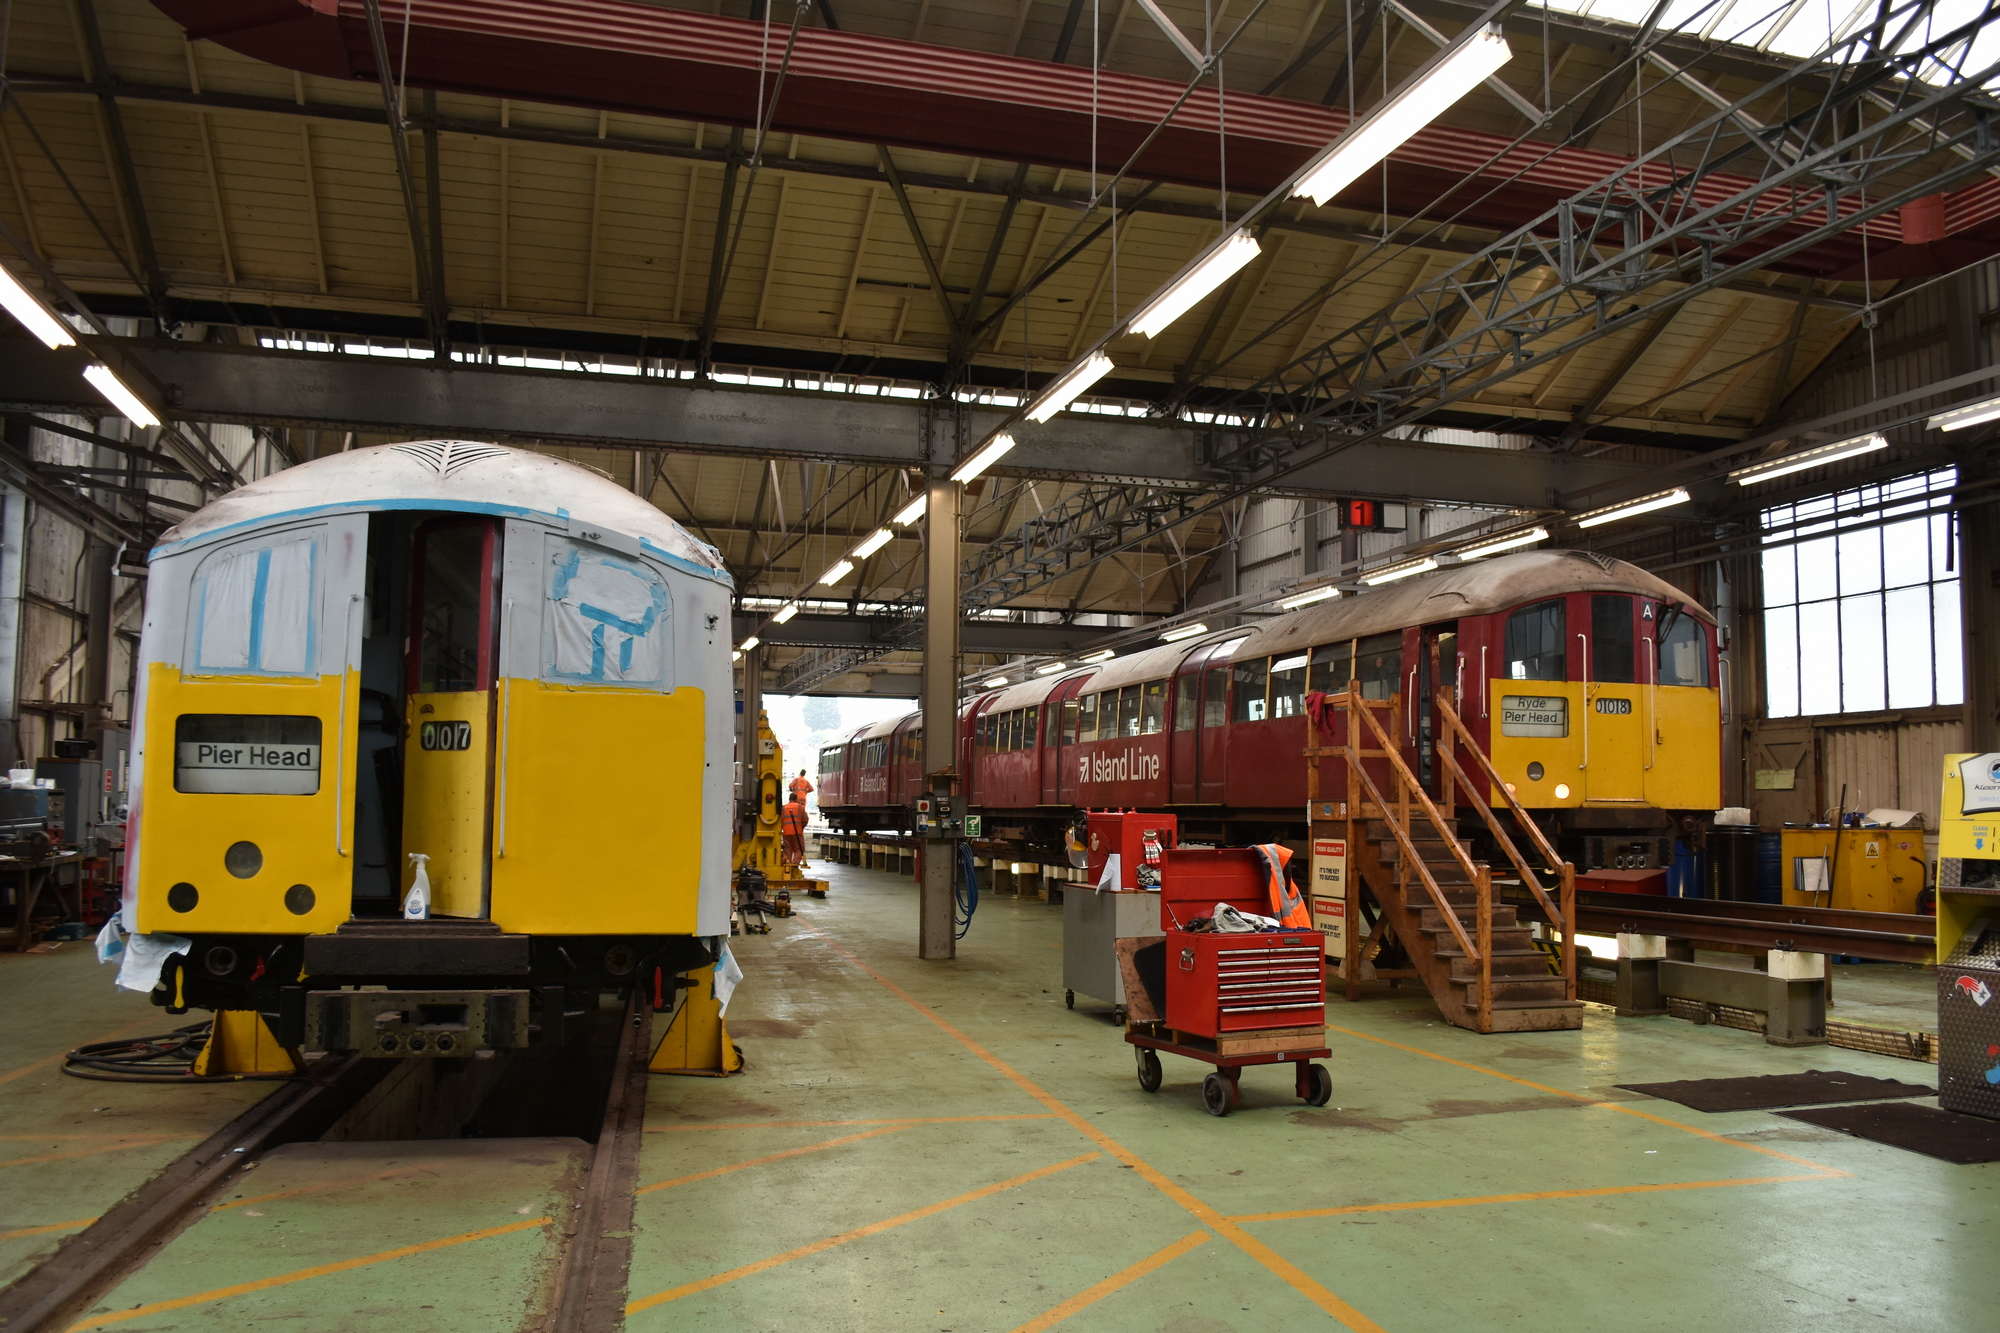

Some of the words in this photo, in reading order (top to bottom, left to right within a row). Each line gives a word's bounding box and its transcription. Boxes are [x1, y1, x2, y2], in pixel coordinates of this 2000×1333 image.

[1355, 503, 1365, 526] 1
[1642, 604, 1653, 618] A
[1518, 697, 1546, 710] Ryde
[1505, 711, 1526, 722] Pier
[1528, 712, 1557, 723] Head
[198, 744, 243, 764] Pier
[250, 746, 311, 766] Head
[1092, 748, 1127, 782] Island
[1130, 746, 1159, 780] Line
[1327, 923, 1339, 931] DOUBT
